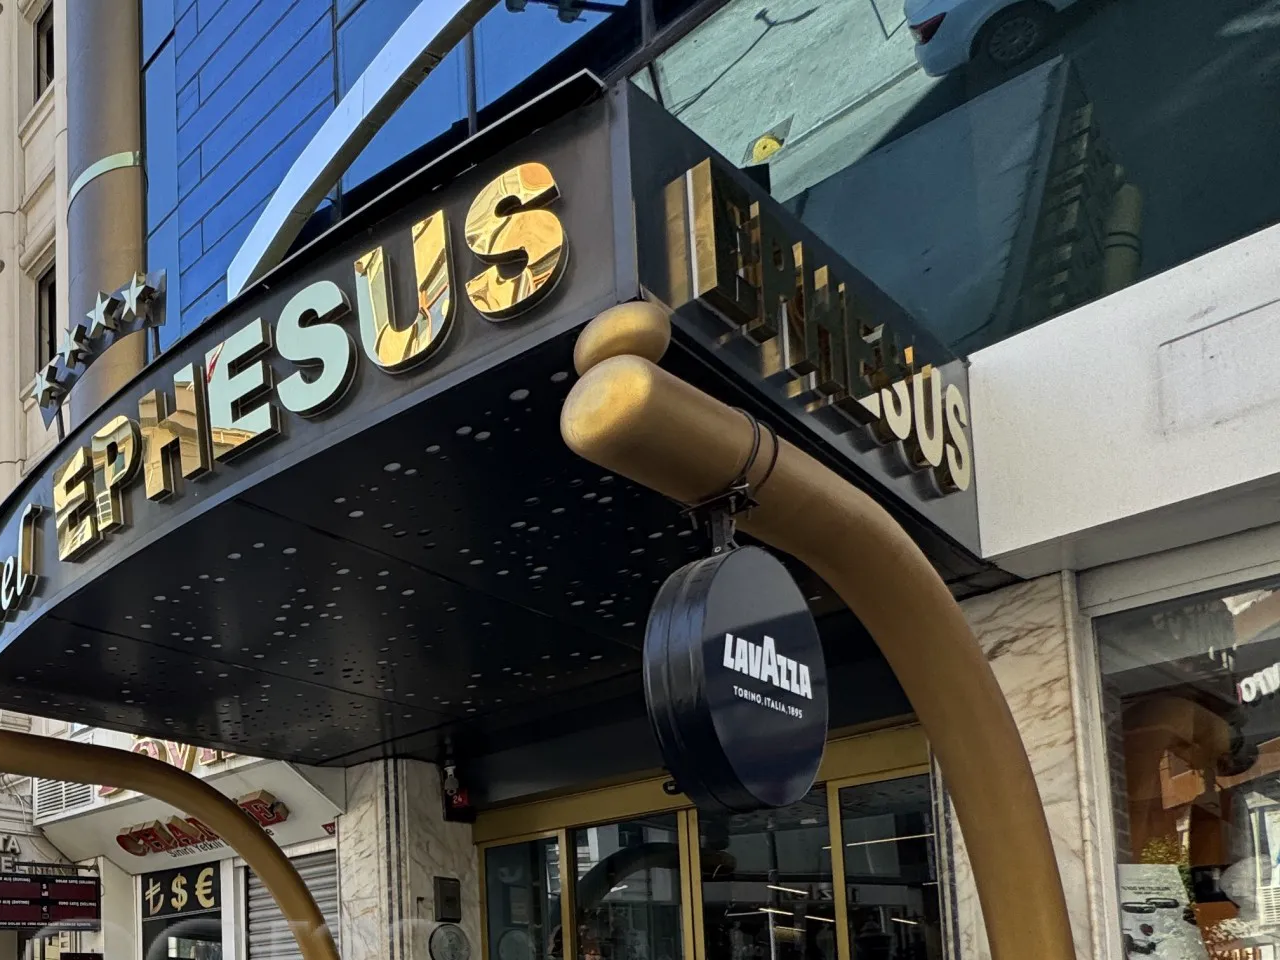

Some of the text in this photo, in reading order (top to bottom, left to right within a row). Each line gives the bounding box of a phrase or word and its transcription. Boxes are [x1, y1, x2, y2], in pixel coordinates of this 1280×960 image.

[53, 161, 569, 563] EPHESUS
[723, 633, 812, 700] LAVAZZA
[788, 705, 803, 719] 1895
[116, 789, 290, 857] CHANE
[171, 875, 188, 911] $
[195, 868, 215, 908] €
